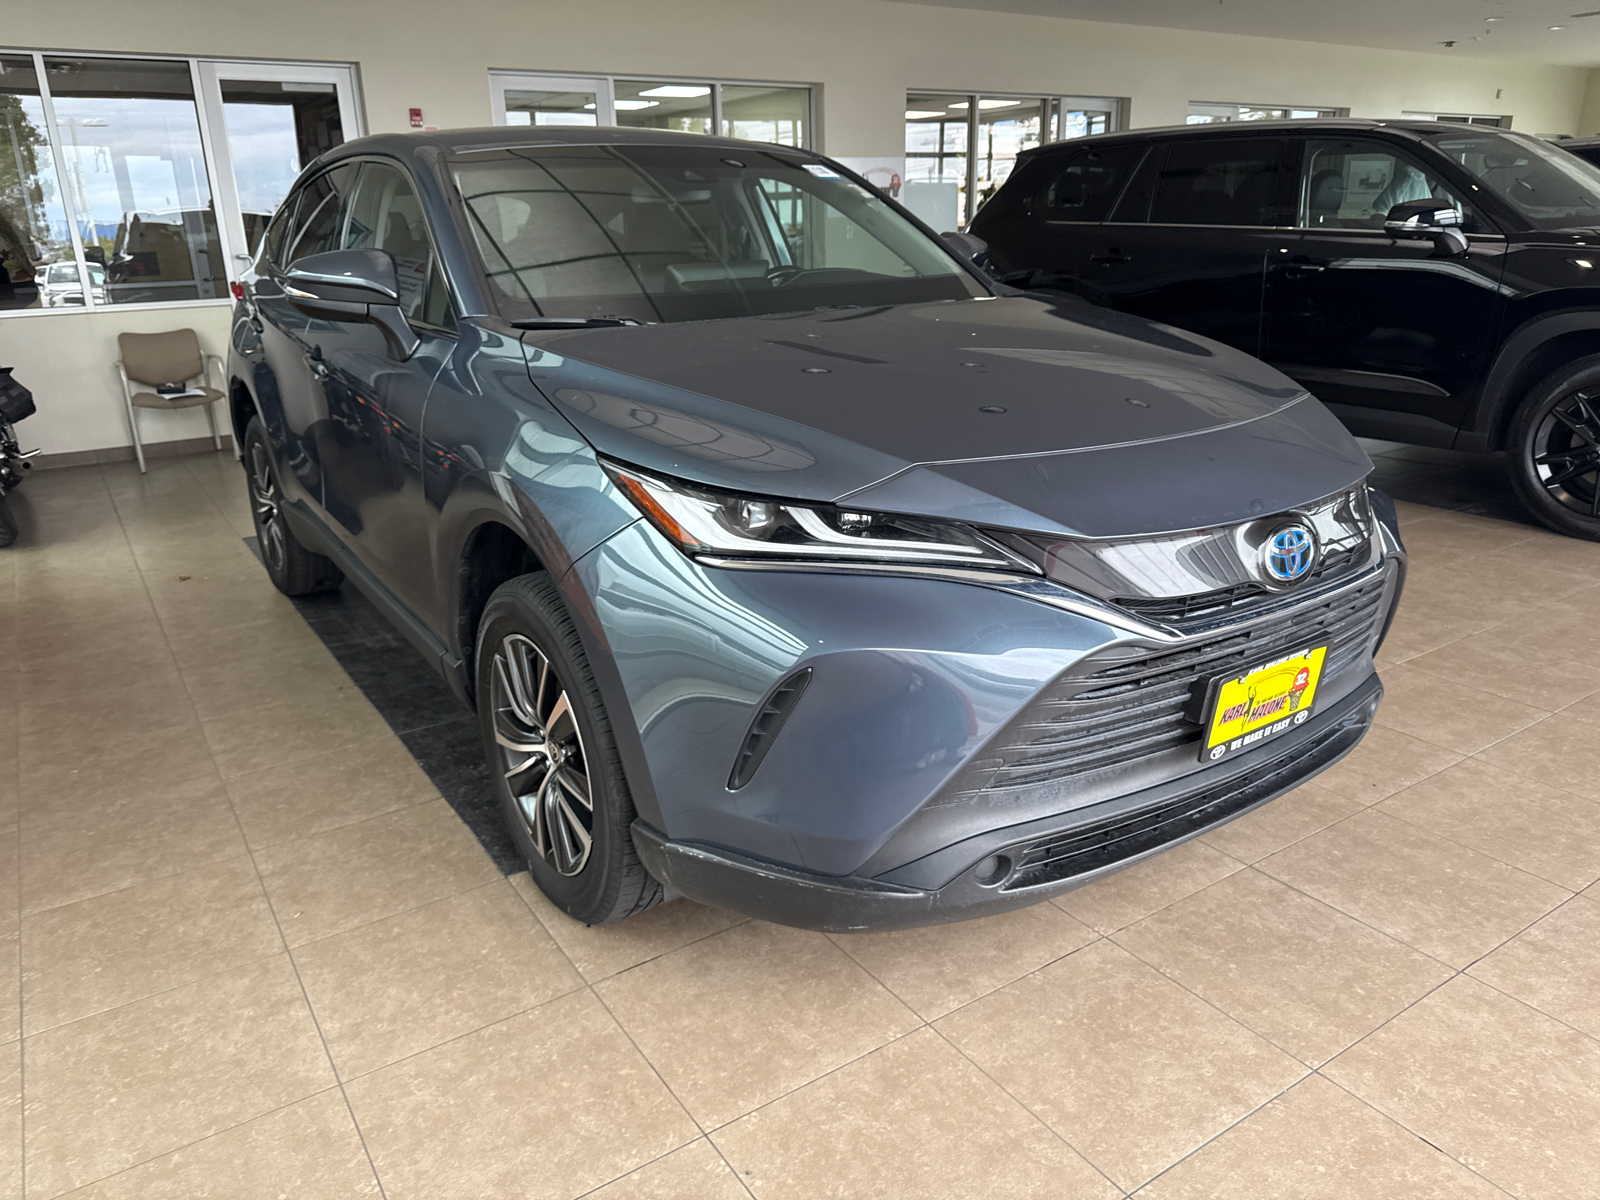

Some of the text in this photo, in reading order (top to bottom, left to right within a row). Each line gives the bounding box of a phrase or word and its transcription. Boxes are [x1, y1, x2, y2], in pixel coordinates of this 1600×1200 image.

[1295, 672, 1307, 685] 32
[1218, 701, 1248, 726] KARL
[1247, 694, 1288, 724] MALONE
[1231, 717, 1291, 751] WE MAKE IT EASY
